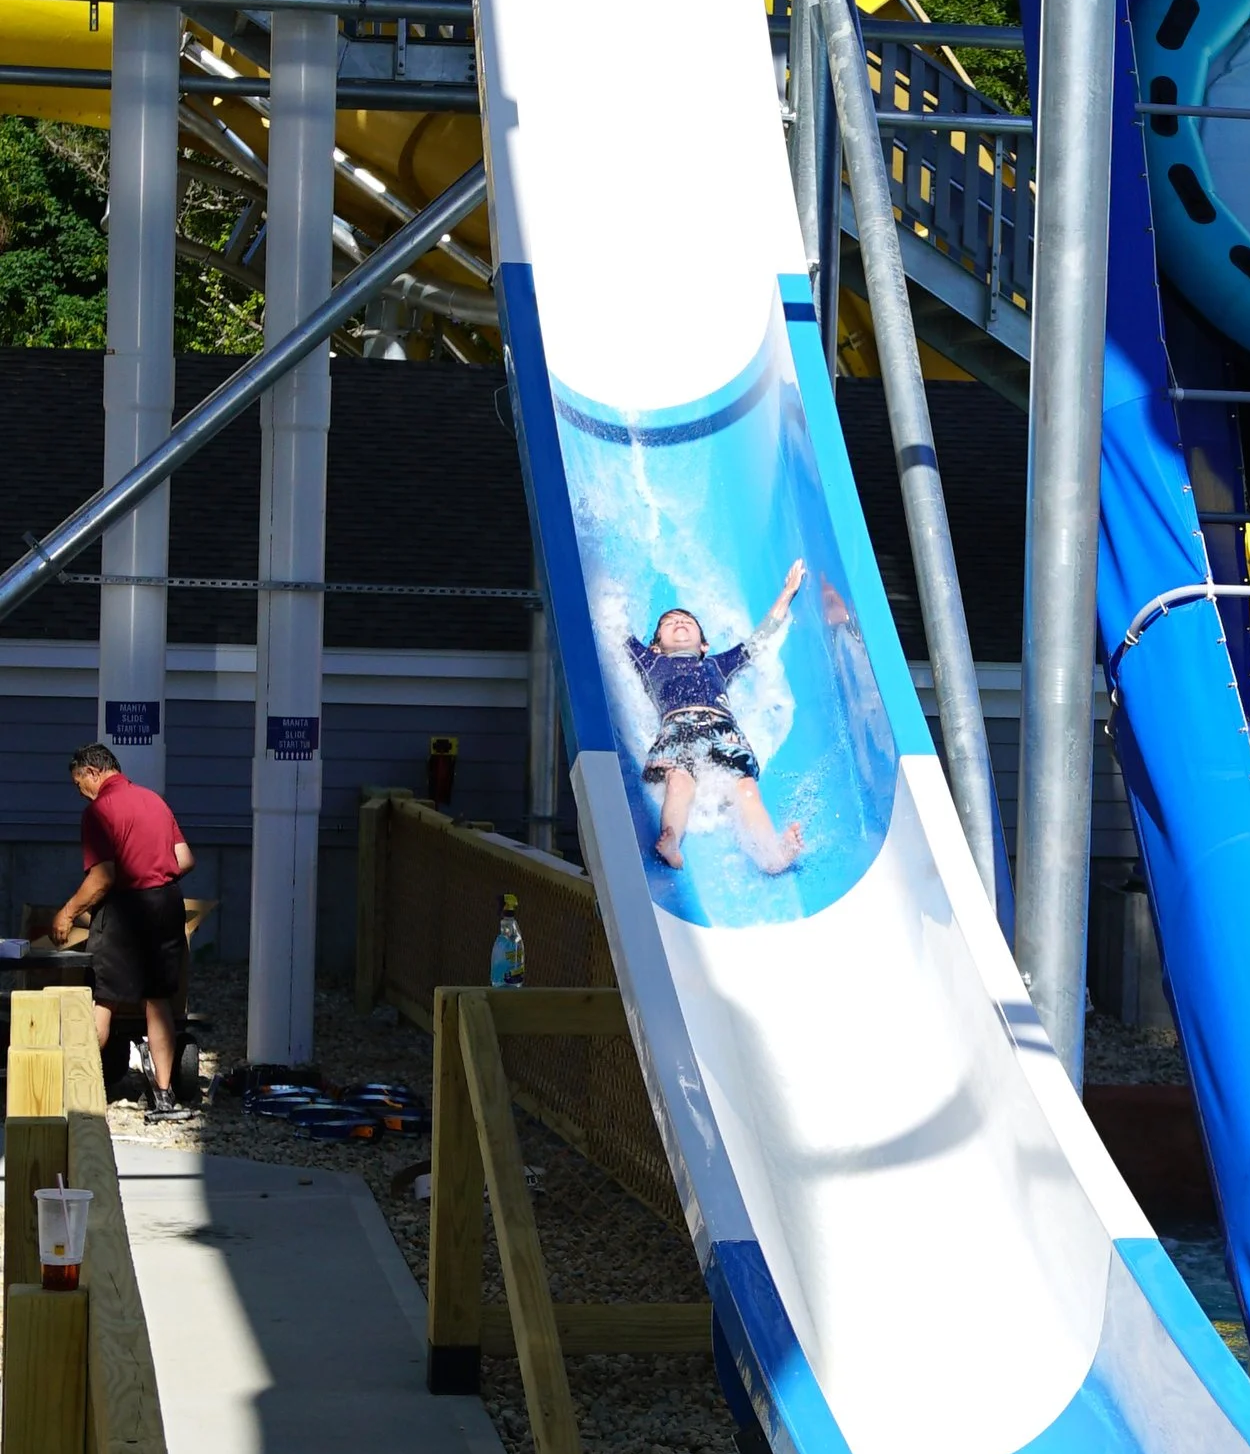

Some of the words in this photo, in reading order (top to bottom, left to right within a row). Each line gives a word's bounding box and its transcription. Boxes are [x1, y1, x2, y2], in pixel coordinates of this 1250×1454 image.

[119, 703, 147, 713] MANTA
[121, 714, 144, 723] SLIDE
[282, 718, 309, 727] MANTA
[116, 724, 136, 733] START
[285, 730, 306, 739] SLIDE
[279, 740, 298, 749] START
